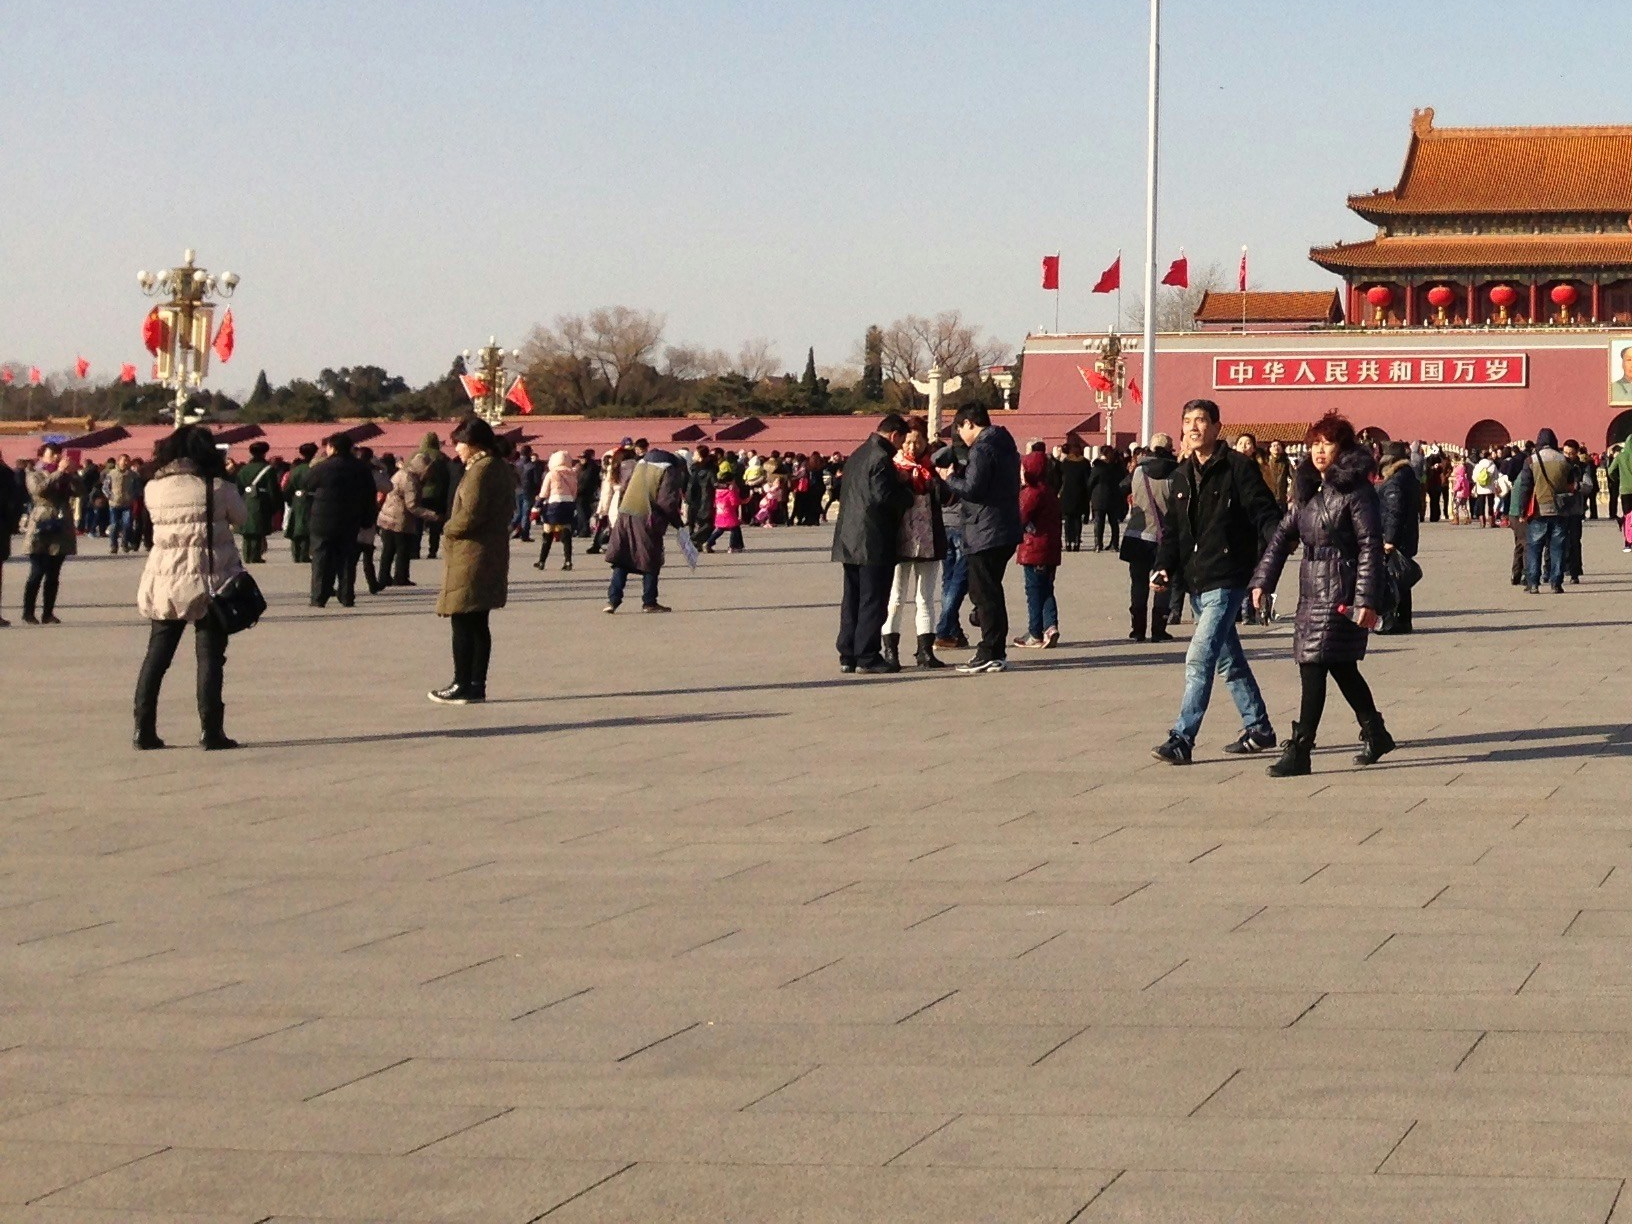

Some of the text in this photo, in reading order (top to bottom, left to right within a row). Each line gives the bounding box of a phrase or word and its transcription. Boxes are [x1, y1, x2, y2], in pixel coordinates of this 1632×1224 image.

[1229, 360, 1509, 382] 中华人民共和国万岁
